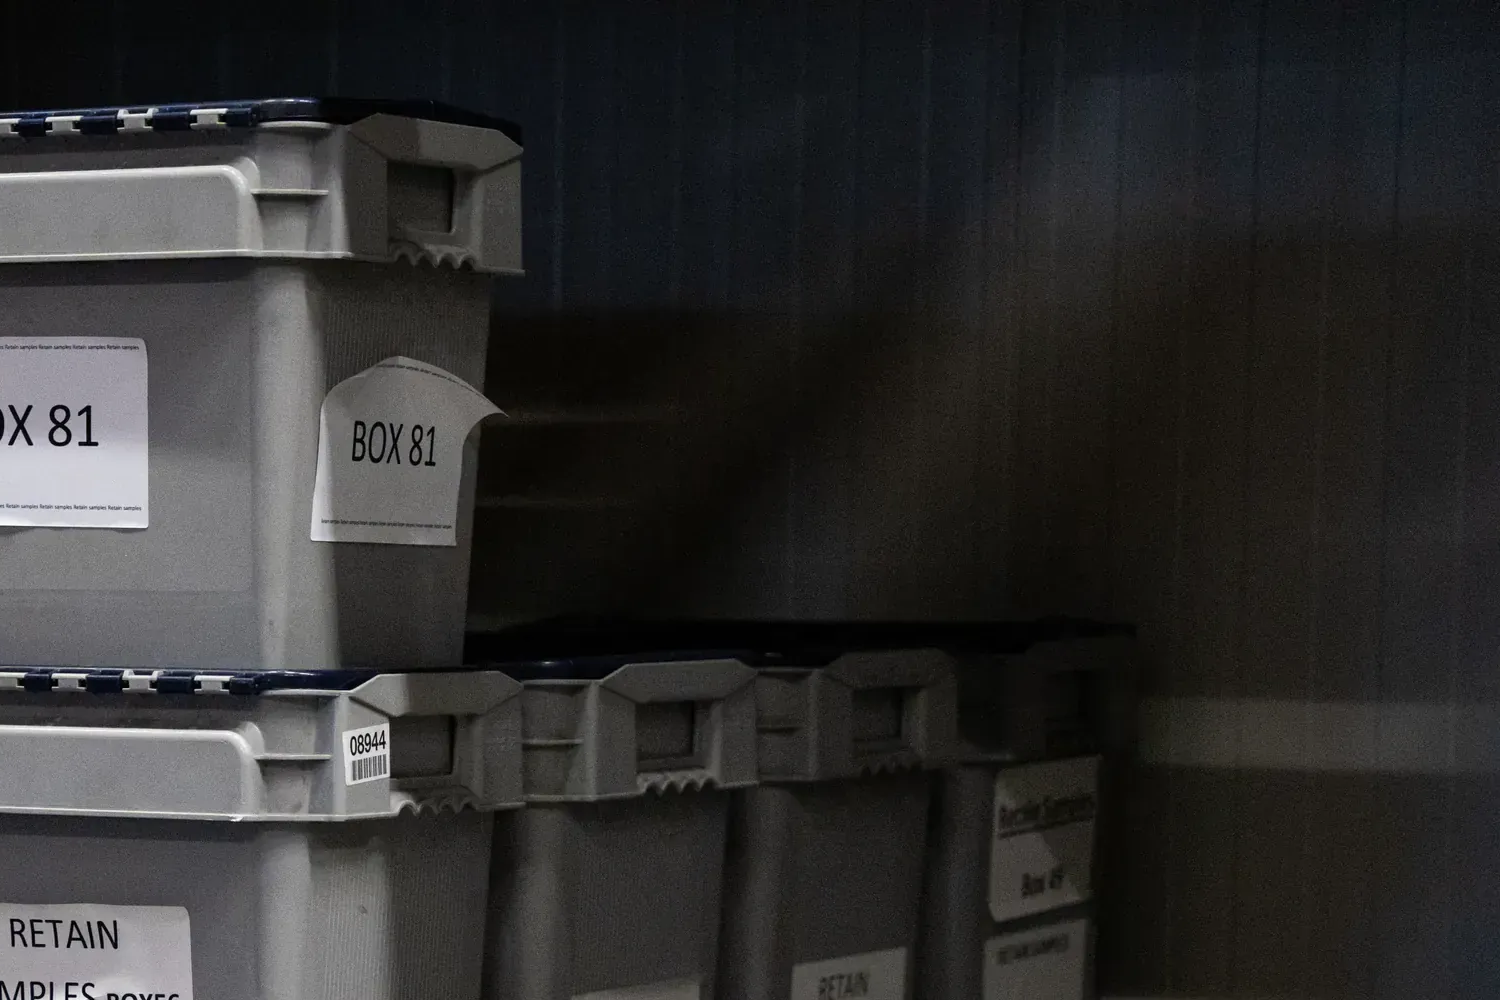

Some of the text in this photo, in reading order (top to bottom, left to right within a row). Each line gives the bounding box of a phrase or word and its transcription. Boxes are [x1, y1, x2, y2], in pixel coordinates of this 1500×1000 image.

[48, 404, 99, 447] 81
[352, 420, 436, 467] BOX 81
[350, 730, 386, 756] 08944
[9, 918, 119, 950] RETAIN
